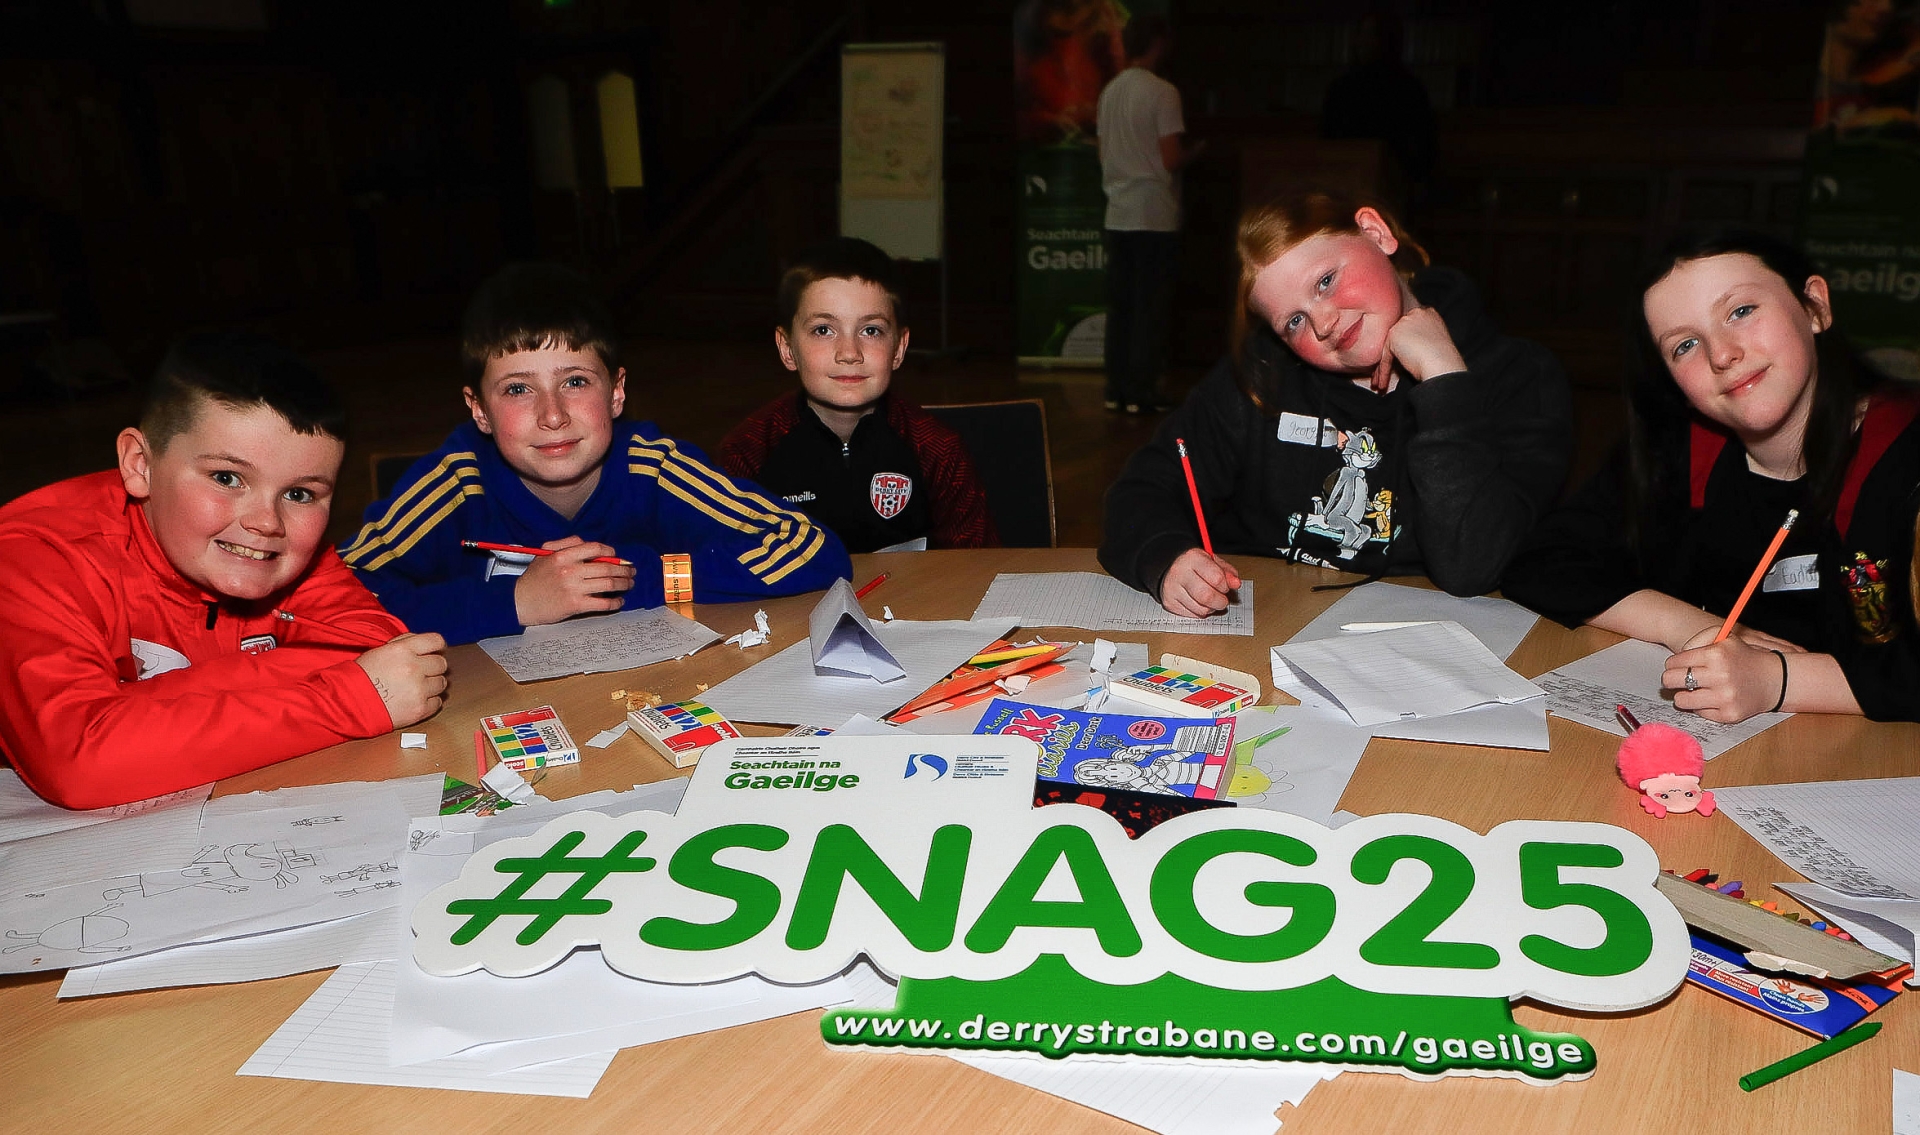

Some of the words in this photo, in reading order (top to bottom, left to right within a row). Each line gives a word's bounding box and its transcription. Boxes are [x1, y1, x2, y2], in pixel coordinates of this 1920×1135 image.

[1818, 262, 1920, 301] aeilg
[1002, 708, 1065, 743] RK
[724, 771, 860, 792] Gaeilge
[729, 759, 817, 770] Seachtain
[819, 760, 841, 770] na
[446, 823, 1653, 977] #SNAG25
[834, 1013, 1583, 1069] www.derrystrabane.com/gaeilge
